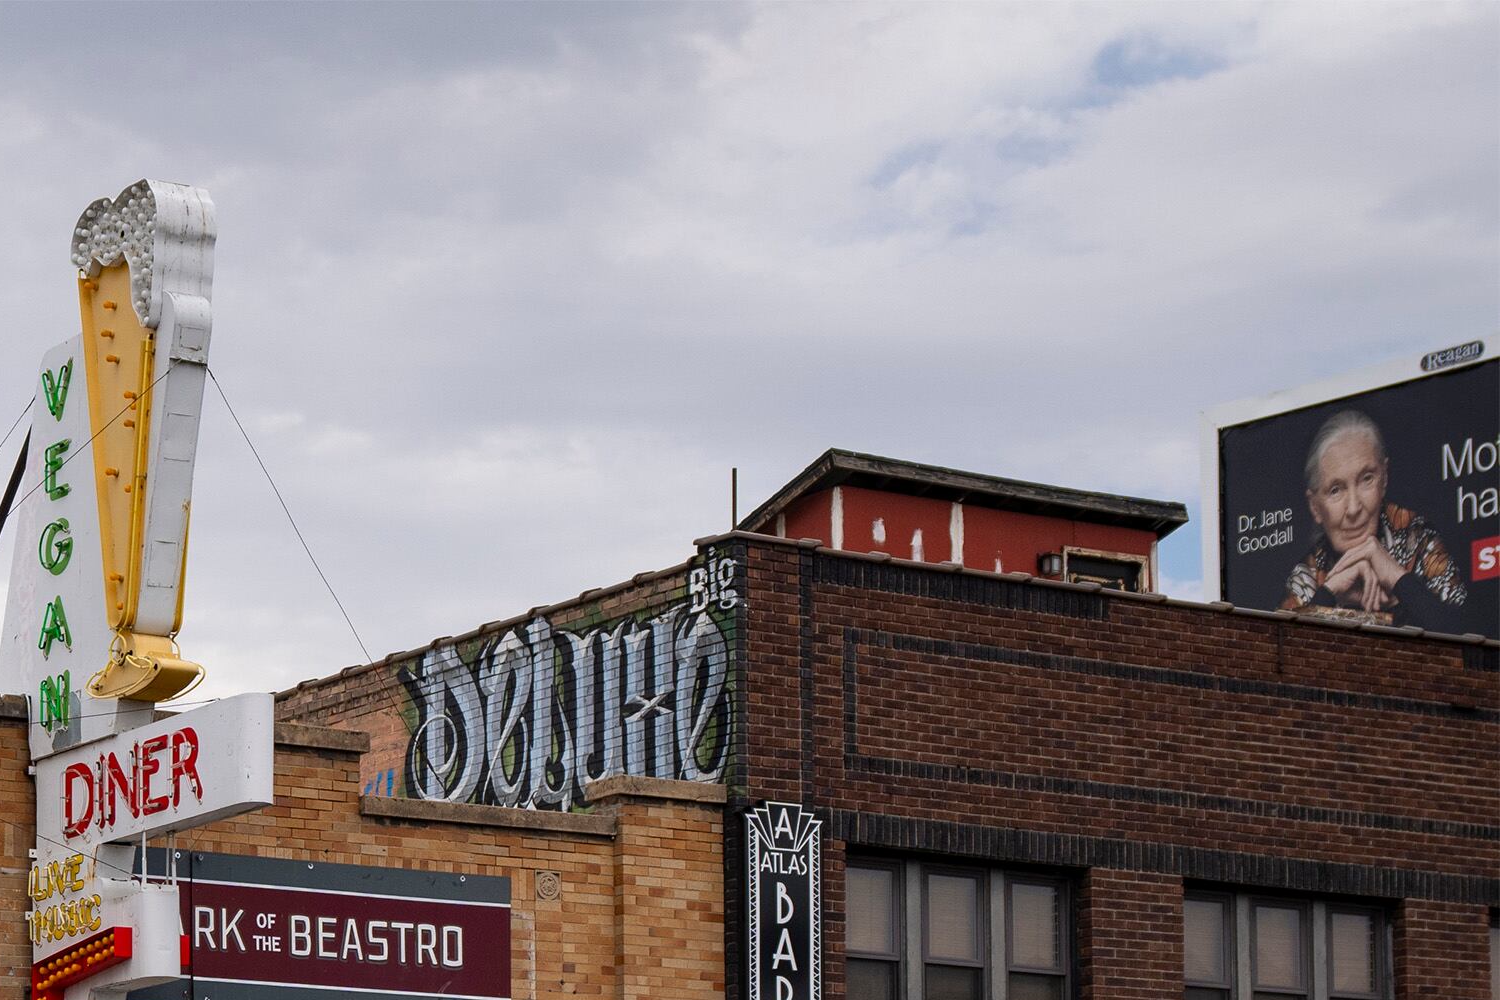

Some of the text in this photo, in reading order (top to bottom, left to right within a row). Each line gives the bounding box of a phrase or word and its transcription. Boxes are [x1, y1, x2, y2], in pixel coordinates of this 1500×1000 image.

[1238, 525, 1293, 554] Goodall
[1239, 508, 1293, 533] Dr. Jane
[38, 356, 74, 738] VEGAN
[60, 726, 205, 844] DINER
[28, 853, 85, 903] LIVE
[760, 852, 808, 877] ATLAS
[29, 893, 102, 947] MUSIC
[180, 906, 465, 968] RK OF THE BEASTRO
